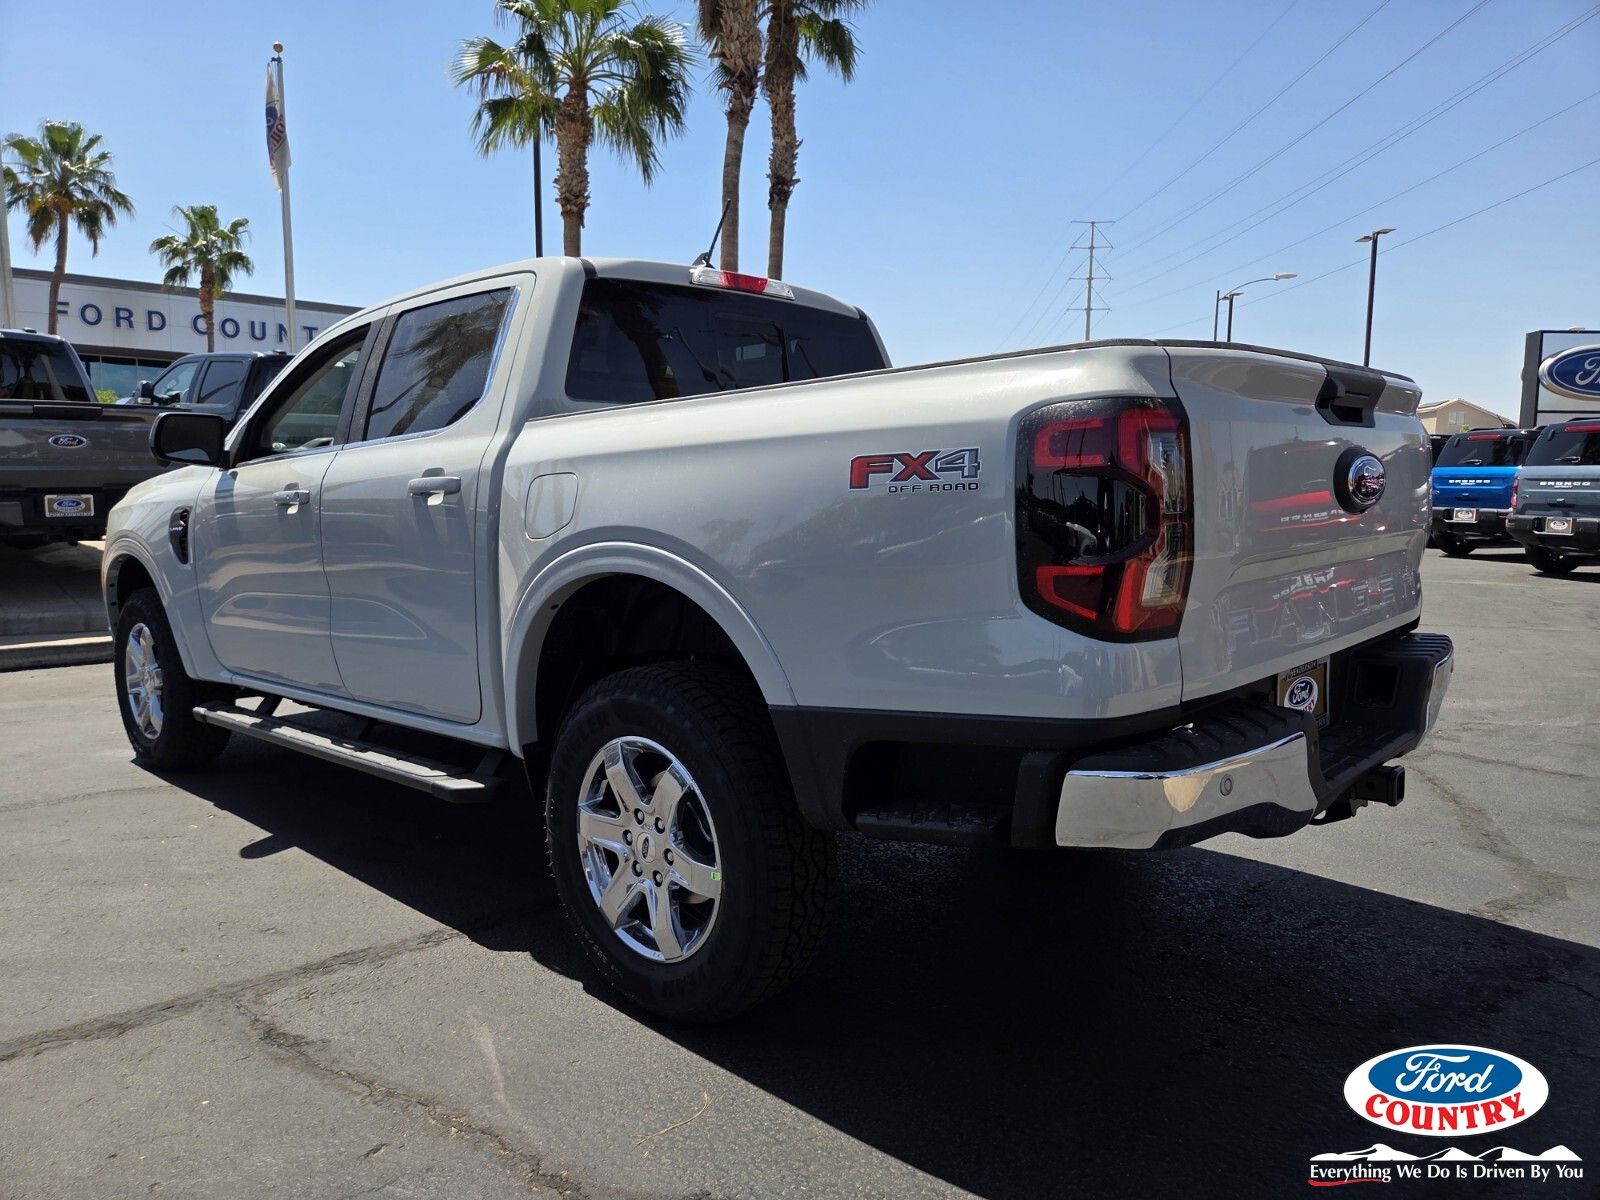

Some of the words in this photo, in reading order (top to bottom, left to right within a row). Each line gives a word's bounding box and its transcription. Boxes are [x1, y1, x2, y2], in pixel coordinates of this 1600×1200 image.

[57, 301, 166, 332] FORD
[849, 447, 981, 491] FX4
[888, 484, 923, 494] OFF
[929, 482, 979, 493] ROAD
